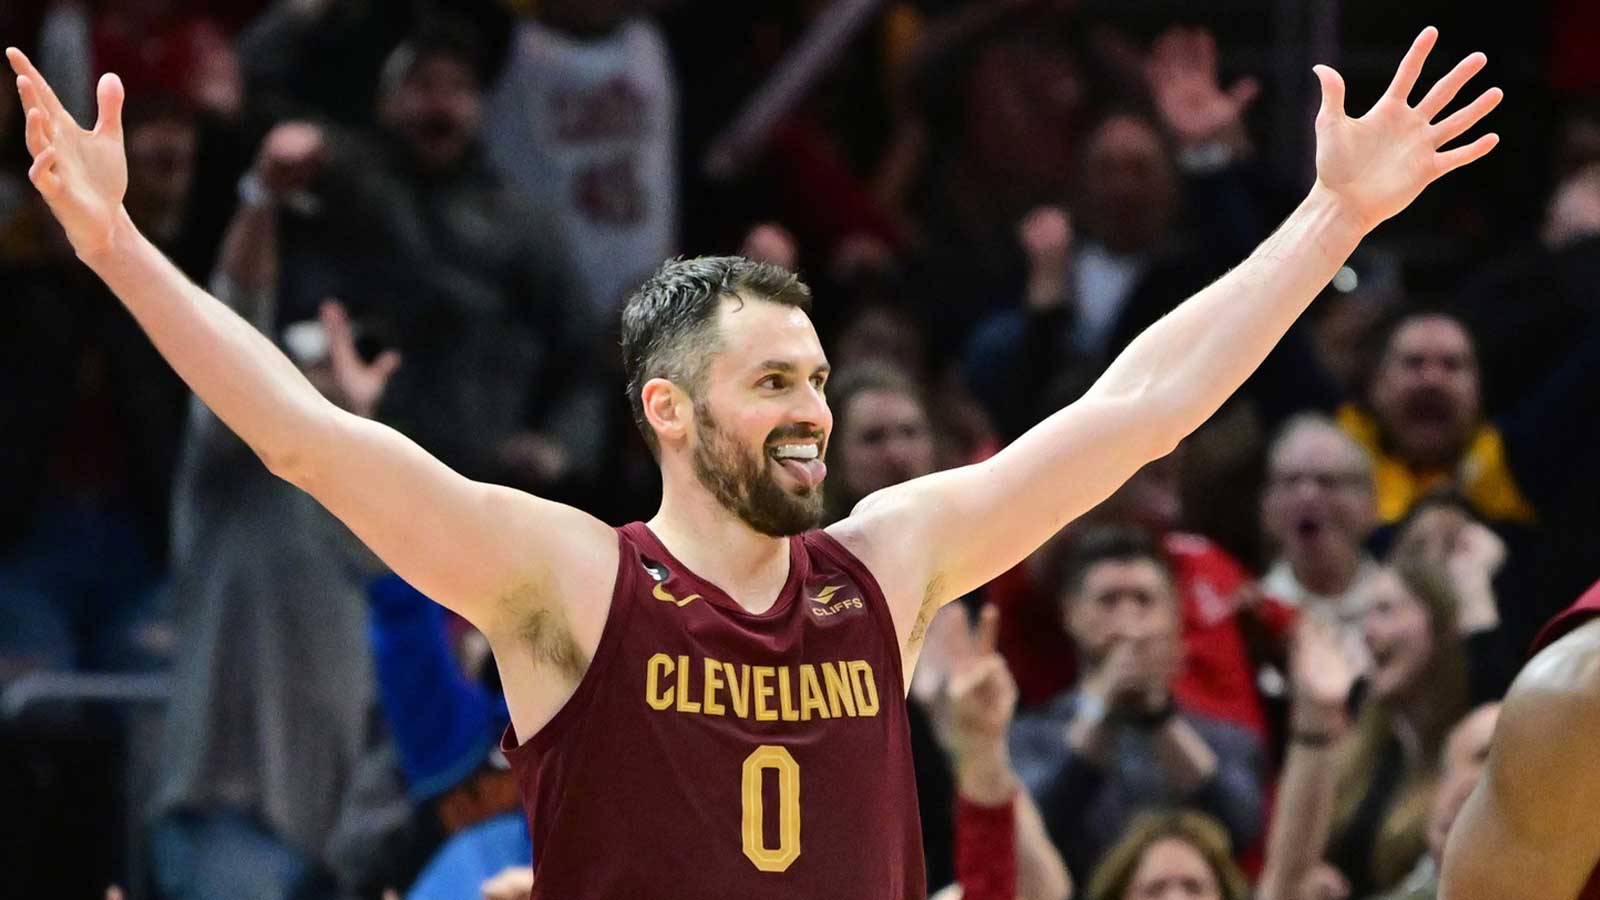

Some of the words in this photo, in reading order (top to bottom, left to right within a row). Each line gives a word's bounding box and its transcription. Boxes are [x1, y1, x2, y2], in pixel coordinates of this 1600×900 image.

[812, 597, 863, 616] CLIFFS
[646, 653, 879, 721] CLEVELAND
[742, 745, 800, 872] 0
